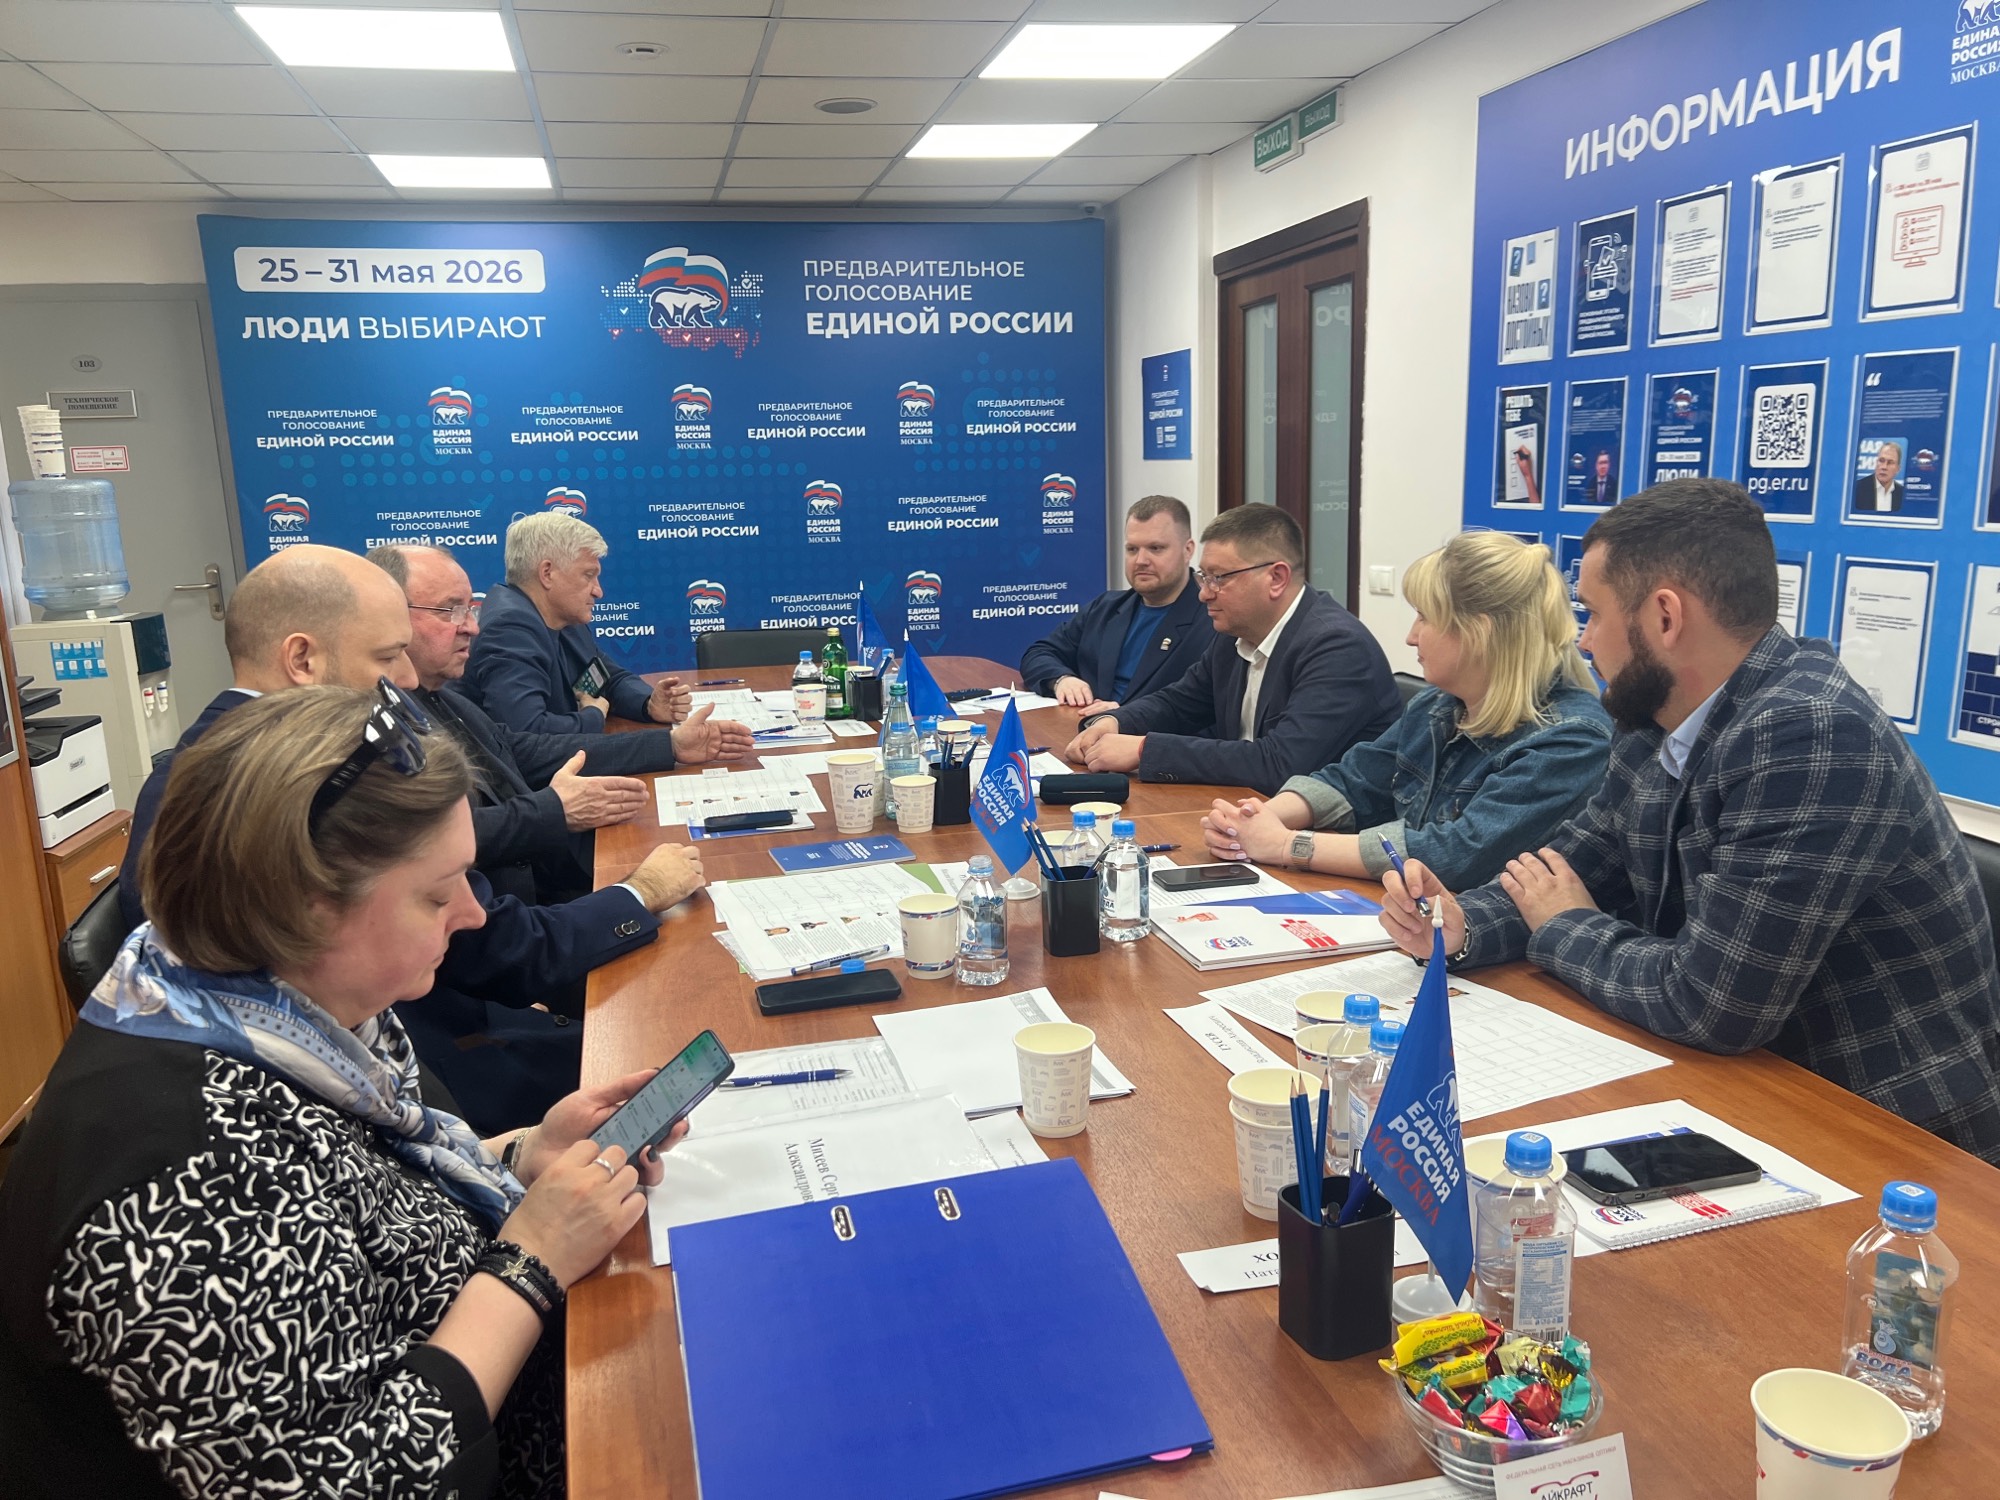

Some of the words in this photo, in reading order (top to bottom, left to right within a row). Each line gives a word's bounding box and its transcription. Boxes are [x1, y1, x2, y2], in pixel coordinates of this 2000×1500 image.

[1952, 26, 2000, 50] ЕДИНА
[1564, 27, 1901, 179] ИНФОРМАЦИЯ
[1304, 103, 1331, 128] ВЫХОД
[1256, 126, 1289, 158] ВЫХОД
[371, 262, 434, 284] мая
[444, 259, 523, 284] 2026
[803, 259, 1025, 279] ПРЕДВАРИТЕЛЬНОЕ
[804, 283, 973, 302] ГОЛОСОВАНИЕ
[806, 305, 941, 337] ЕДИНОЙ
[950, 311, 1074, 334] РОССИИ
[242, 316, 350, 343] ЛЮДИ
[359, 315, 546, 340] ВЫБИРАЮТ
[79, 360, 95, 368] 103
[63, 396, 120, 404] ТЕХНИЧЕСКОЕ
[977, 398, 1065, 409] ПРЕДВАРИТЕЛЬНОЕ
[67, 402, 117, 411] ПОМЕЩЕНИЕ
[522, 405, 624, 416] ПРЕДВАРИТЕЛЬНОЕ
[758, 402, 853, 412] ПРЕДВАРИТЕЛЬНОЕ
[267, 408, 378, 421] ПРЕДВАРИТЕЛЬНОЕ
[770, 412, 842, 423] ГОЛОСОВАНИЕ
[988, 408, 1055, 418] ГОЛОСОВАНИЕ
[282, 420, 366, 431] ГОЛОСОВАНИЕ
[535, 416, 613, 427] ГОЛОСОВАНИЕ
[899, 420, 933, 429] ЕДИНАЯ
[674, 424, 711, 433] ЕДИНАЯ
[747, 424, 807, 440] ЕДИНОЙ
[809, 426, 866, 438] РОССИИ
[899, 427, 933, 436] РОССИЯ
[966, 419, 1022, 436] ЕДИНОЙ
[1024, 421, 1077, 434] РОССИИ
[432, 429, 472, 438] ЕДИНАЯ
[511, 429, 575, 445] ЕДИНОЙ
[577, 430, 639, 442] РОССИИ
[674, 431, 711, 440] РОССИЯ
[256, 432, 327, 449] ЕДИНОЙ
[329, 434, 394, 447] РОССИИ
[432, 435, 473, 445] РОССИЯ
[676, 440, 712, 450] МОСКВА
[900, 437, 934, 445] МОСКВА
[434, 446, 473, 455] МОСКВА
[1748, 476, 1808, 494] pg.er.ru
[898, 494, 987, 505] ПРЕДВАРИТЕЛЬНОЕ
[648, 502, 746, 513] ПРЕДВАРИТЕЛЬНОЕ
[909, 505, 977, 515] ГОЛОСОВАНИЕ
[376, 509, 482, 521] ПРЕДВАРИТЕЛЬНОЕ
[661, 512, 735, 523] ГОЛОСОВАНИЕ
[1042, 511, 1074, 519] ЕДИНАЯ
[391, 521, 470, 531] ГОЛОСОВАНИЕ
[806, 519, 841, 528] ЕДИНАЯ
[887, 515, 945, 532] ЕДИНОЙ
[947, 518, 1000, 530] РОССИИ
[1042, 517, 1074, 526] РОССИЯ
[637, 525, 699, 541] ЕДИНОЙ
[701, 526, 760, 538] РОССИИ
[806, 525, 842, 534] РОССИЯ
[1043, 526, 1074, 534] МОСКВА
[268, 535, 309, 544] ЕДИНАЯ
[434, 534, 498, 547] РОССИИ
[808, 535, 842, 544] МОСКВА
[983, 582, 1068, 594] ПРЕДВАРИТЕЛЬНОЕ
[993, 592, 1058, 603] ГОЛОСОВАНИЕ
[783, 603, 853, 613] ГОЛОСОВАНИЕ
[907, 607, 940, 616] ЕДИНАЯ
[972, 603, 1026, 619] ЕДИНОЙ
[1028, 603, 1079, 616] РОССИИ
[689, 617, 725, 627] ЕДИНАЯ
[760, 615, 818, 630] ЕДИНОЙ
[820, 615, 857, 627] РОСС
[907, 613, 940, 622] РОССИЯ
[595, 625, 655, 638] РОССИИ
[690, 625, 726, 633] РОССИЯ
[908, 622, 940, 632] МОСКВА
[983, 775, 1015, 820] ЕДИНАЯ
[977, 782, 1007, 826] РОССИЯ
[1406, 1101, 1460, 1187] ЕДИНАЯ
[1387, 1115, 1451, 1204] РОССИЯ
[784, 1143, 815, 1203] Александров
[808, 1138, 830, 1174] Михеев
[820, 1173, 840, 1202] Серг
[1370, 1124, 1439, 1226] МОСКВА
[1856, 1351, 1911, 1377] ВОДА
[1505, 1465, 1547, 1480] ФЕДЕРАЛЬНАЯ
[1547, 1461, 1562, 1470] СЕТЬ
[1562, 1452, 1594, 1466] МАГАЗИНОВ
[1595, 1445, 1617, 1457] ОПТИКИ
